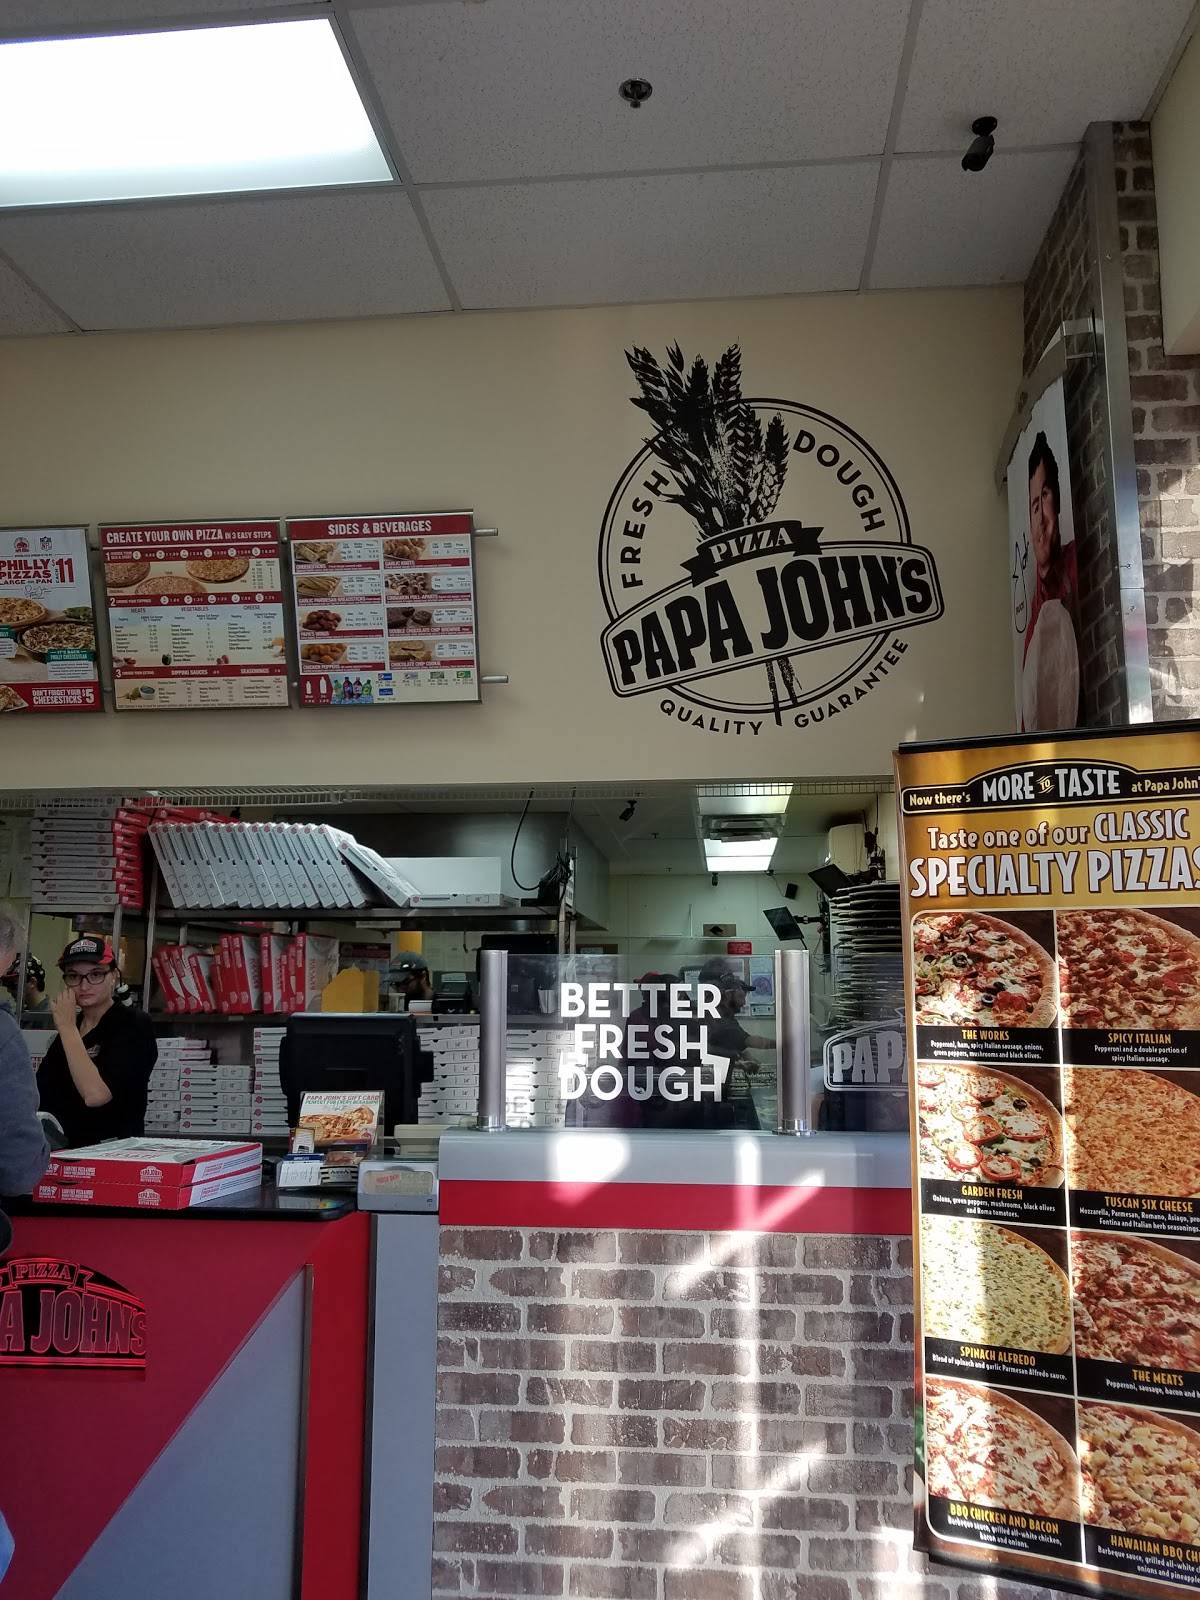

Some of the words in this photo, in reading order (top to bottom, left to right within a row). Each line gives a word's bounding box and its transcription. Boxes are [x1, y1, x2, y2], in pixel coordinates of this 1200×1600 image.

[620, 469, 671, 589] FRESH
[793, 429, 885, 532] DOUGH
[106, 531, 143, 544] CREATE
[144, 530, 170, 542] YOUR
[172, 529, 194, 541] OWN
[196, 528, 223, 541] PIZZA
[225, 532, 231, 540] IN
[237, 531, 252, 539] EASY
[252, 530, 272, 539] STEPS
[327, 522, 360, 536] SIDES
[362, 522, 371, 534] &
[373, 520, 432, 533] BEVERAGES
[710, 527, 793, 564] PIZZA
[0, 559, 51, 570] PHILLY
[0, 571, 52, 580] PIZZAS
[110, 597, 116, 606] 2
[612, 579, 754, 686] PAPA
[756, 555, 932, 651] JOHN'S
[116, 668, 121, 677] 3
[660, 699, 762, 735] QUALITY
[794, 638, 909, 728] GUARANTEE
[909, 793, 932, 806] Now
[934, 791, 970, 804] there's
[982, 771, 1035, 802] MORE
[1055, 769, 1120, 798] TASTE
[1131, 782, 1142, 792] at
[1144, 779, 1169, 793] Papa
[928, 827, 978, 850] Taste
[982, 830, 1021, 848] one
[1025, 821, 1050, 846] of
[1052, 825, 1089, 844] our
[1093, 808, 1189, 842] CLASSIC
[909, 851, 1080, 897] SPECIALTY
[559, 982, 722, 1019] BETTER
[574, 1024, 708, 1060] FRESH
[961, 1029, 977, 1040] THE
[979, 1030, 1009, 1041] WORKS
[1108, 1032, 1132, 1043] SPICY
[1136, 1033, 1171, 1044] ITALIAN
[969, 1050, 998, 1058] mushrooms
[1009, 1051, 1023, 1059] black
[970, 1041, 984, 1050] spicy
[1002, 1043, 1023, 1051] sausage,
[1024, 1044, 1044, 1052] onions,
[1094, 1044, 1122, 1054] Pepperoni
[1122, 1045, 1134, 1053] and
[1138, 1046, 1157, 1054] double
[1158, 1047, 1180, 1055] portion
[831, 1030, 909, 1084] PAP
[1111, 1055, 1125, 1063] spicy
[1146, 1056, 1170, 1064] sausage.
[559, 1064, 722, 1102] DOUGH
[961, 1185, 994, 1198] GARDEN
[996, 1188, 1023, 1200] FRESH
[967, 1199, 989, 1208] peppers,
[990, 1201, 1022, 1211] mushrooms,
[1023, 1203, 1038, 1211] black
[1039, 1204, 1056, 1212] olives
[1104, 1196, 1140, 1210] TUSCAN
[1142, 1198, 1157, 1211] SIX
[1159, 1200, 1193, 1213] CHEESE
[1079, 1206, 1110, 1218] Mozzarella,
[1111, 1210, 1140, 1220] Parmesan,
[1141, 1211, 1167, 1221] Romano,
[1168, 1213, 1189, 1223] Asiago,
[1099, 1217, 1120, 1227] Fontina
[1121, 1219, 1132, 1228] and
[1133, 1220, 1152, 1229] Italian
[1152, 1221, 1166, 1231] herb
[15, 1263, 71, 1280] PIZZA
[960, 1345, 995, 1361] SPINACH
[997, 1351, 1036, 1366] ALFREDO
[985, 1363, 1002, 1373] garlic
[1002, 1365, 1028, 1376] Parmesan
[1029, 1367, 1049, 1379] Alfredo
[1050, 1372, 1067, 1382] sauce.
[1132, 1368, 1150, 1383] THE
[1153, 1371, 1184, 1387] MEATS
[1105, 1378, 1137, 1391] Pepperoni,
[1138, 1384, 1164, 1396] sausage,
[1164, 1386, 1184, 1397] bacon
[1184, 1389, 1195, 1398] and
[949, 1502, 969, 1520] BBQ
[969, 1506, 1006, 1525] CHICKEN
[1008, 1513, 1026, 1529] AND
[1029, 1516, 1059, 1535] BACON
[979, 1531, 996, 1542] bacon
[996, 1536, 1007, 1545] and
[1010, 1527, 1037, 1540] all-white
[1038, 1534, 1062, 1546] chicken,
[1110, 1534, 1160, 1555] HAWAIIAN
[1162, 1544, 1184, 1563] BBQ
[1097, 1544, 1125, 1559] Barbeque
[1126, 1553, 1144, 1565] sauce,
[1145, 1556, 1165, 1567] grilled
[1166, 1559, 1195, 1573] all-white
[1136, 1565, 1157, 1575] onions
[1158, 1567, 1169, 1577] and
